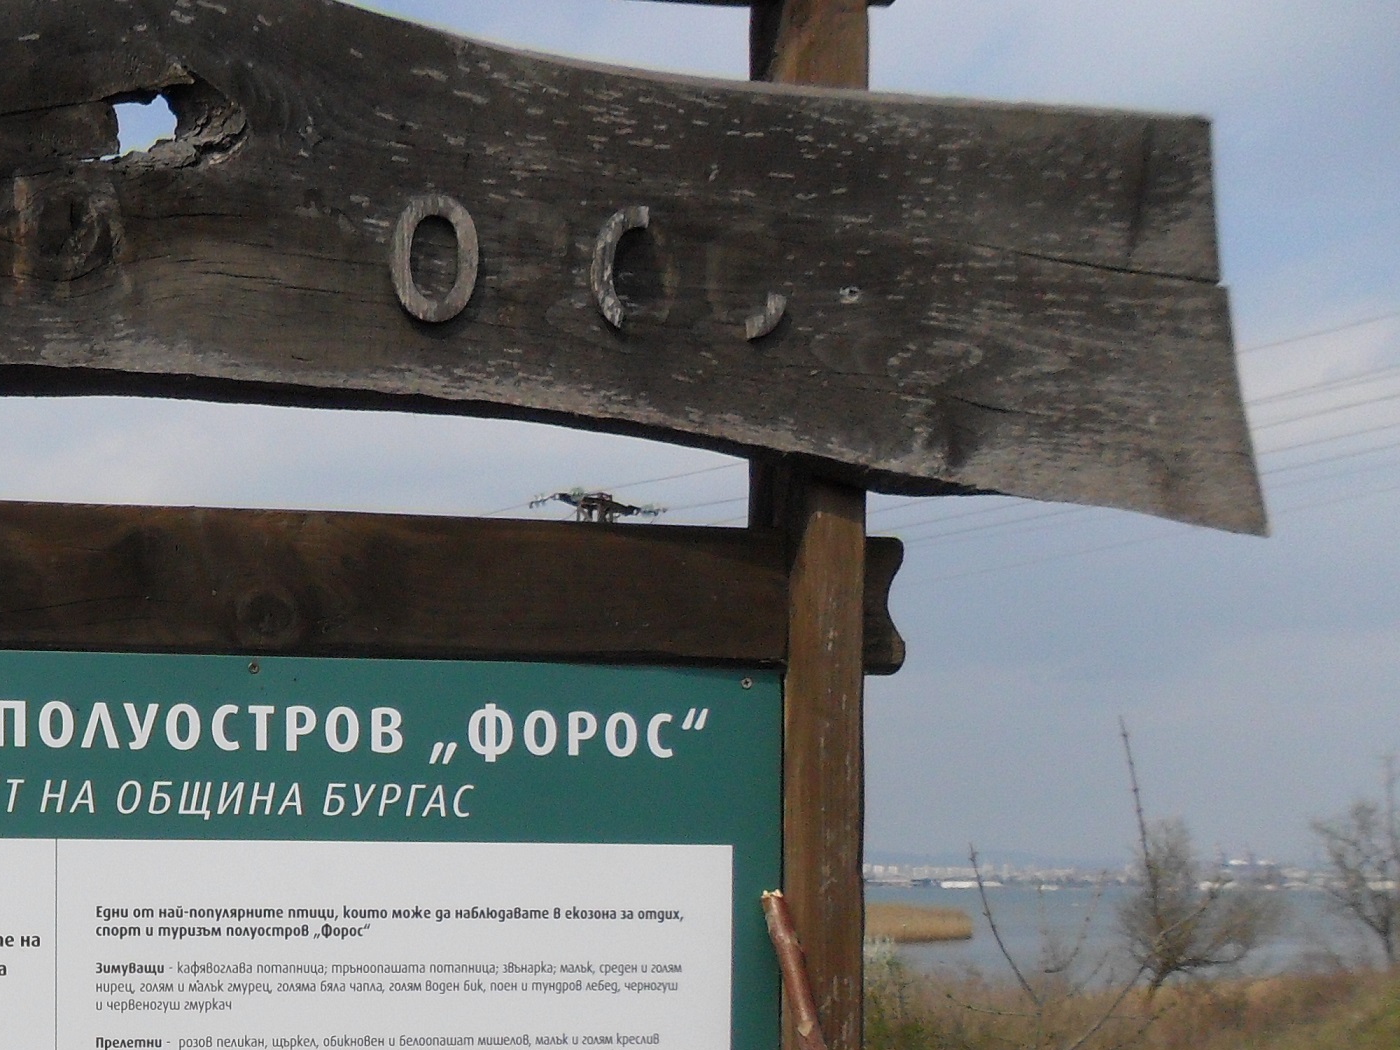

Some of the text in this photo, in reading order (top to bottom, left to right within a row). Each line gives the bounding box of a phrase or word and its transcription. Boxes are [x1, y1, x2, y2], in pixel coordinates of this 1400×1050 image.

[40, 780, 94, 813] НА
[117, 780, 302, 820] ОБЩИНА
[323, 783, 474, 817] БУРГАС
[95, 925, 141, 940] спорт
[145, 926, 154, 937] и
[157, 926, 222, 941] туризъм
[225, 923, 310, 941] полуостров
[20, 935, 41, 948] на
[95, 997, 233, 1014] и червеногуш гмуркач
